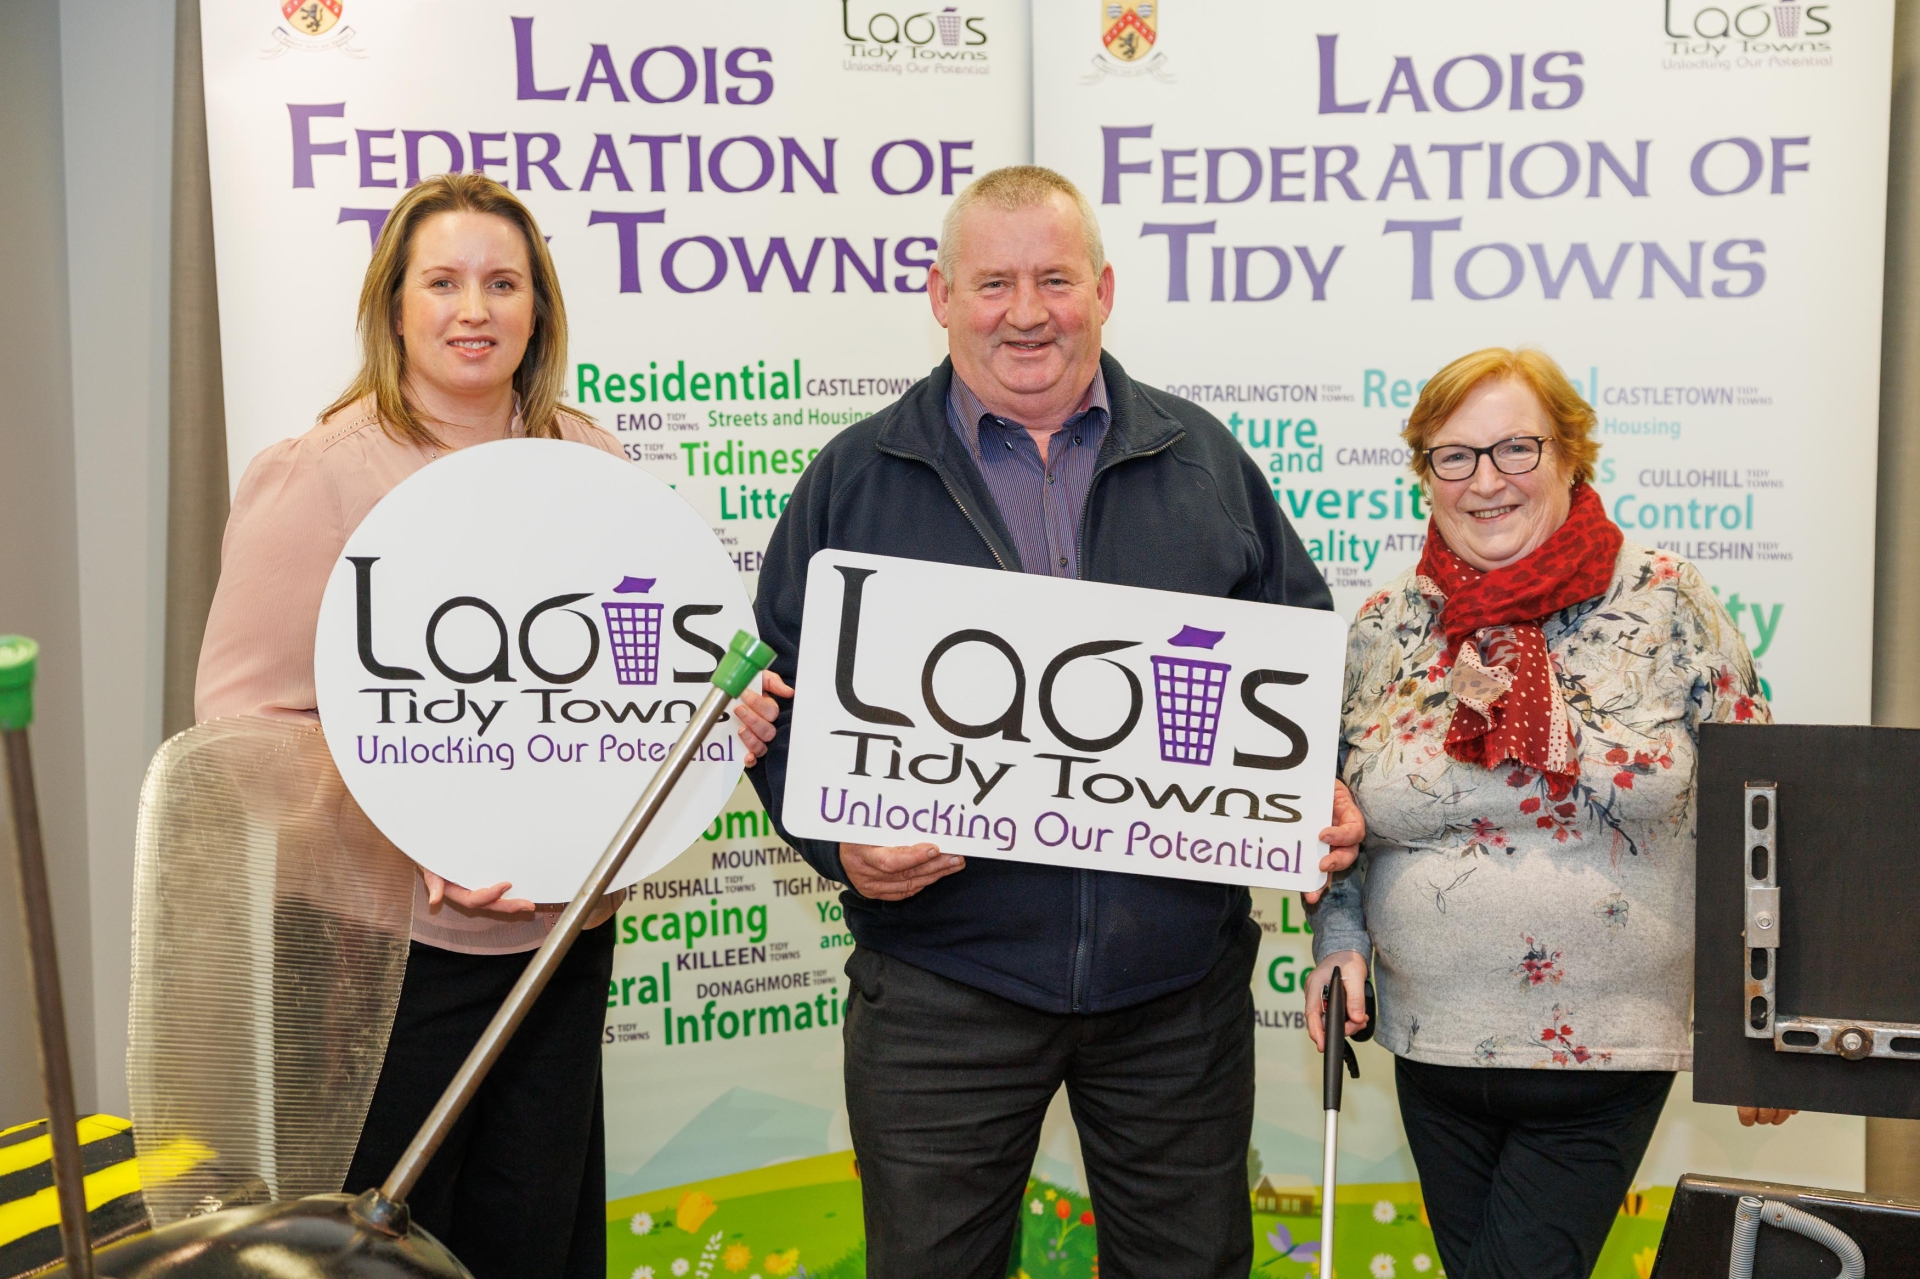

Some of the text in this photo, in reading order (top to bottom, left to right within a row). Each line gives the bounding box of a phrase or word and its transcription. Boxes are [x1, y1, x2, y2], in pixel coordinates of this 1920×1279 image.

[845, 44, 988, 62] Tidy Towns
[1665, 39, 1831, 57] Tidy Towns
[907, 62, 929, 73] Our
[935, 62, 990, 75] Potential
[871, 139, 974, 195] OF
[1690, 136, 1811, 196] OF
[577, 359, 801, 403] Residential
[1321, 384, 1342, 393] TIDY
[1166, 384, 1317, 402] PORTARLINGTON
[1321, 394, 1355, 402] TOWNS
[1603, 386, 1733, 405] CASTLETOWN
[1737, 386, 1760, 394] TIDY
[1737, 396, 1773, 405] TOWNS
[617, 413, 663, 431] EMO
[667, 413, 687, 421] TIDY
[708, 410, 768, 428] Streets
[772, 408, 803, 427] and
[667, 423, 700, 431] TOWNS
[1228, 411, 1317, 448] ture
[1604, 417, 1682, 439] Housing
[644, 452, 677, 461] TOWNS
[1269, 445, 1323, 473] and
[1336, 448, 1413, 465] CAMROS
[1639, 468, 1743, 488] CULLOHILL
[1747, 469, 1770, 478] TIDY
[1747, 479, 1784, 489] TOWNS
[1613, 493, 1753, 530] Control
[1757, 541, 1780, 549] TIDY
[1757, 551, 1793, 561] TOWNS
[1336, 568, 1358, 576] TIDY
[1336, 578, 1373, 587] TOWNS
[358, 688, 731, 736] Tidy Town
[357, 734, 734, 770] Unlocking Our Poteial
[830, 729, 1302, 824] Tidy Towns
[820, 787, 1017, 851] Unlocking
[1034, 811, 1115, 853] Our
[1124, 820, 1302, 874] Potential
[725, 875, 744, 884] TIDY
[725, 883, 756, 893] TOWNS
[773, 876, 812, 897] TIGH
[643, 878, 723, 900] RUSHALL
[769, 942, 790, 951] TIDY
[677, 945, 766, 971] KILLEEN
[769, 951, 801, 962] TOWNS
[813, 969, 828, 977] TIDY
[813, 976, 836, 986] TOWNS
[697, 971, 811, 999] DONAGHMORE
[664, 987, 846, 1045] Informati
[617, 1023, 638, 1032] TIDY
[617, 1032, 650, 1042] TOWNS
